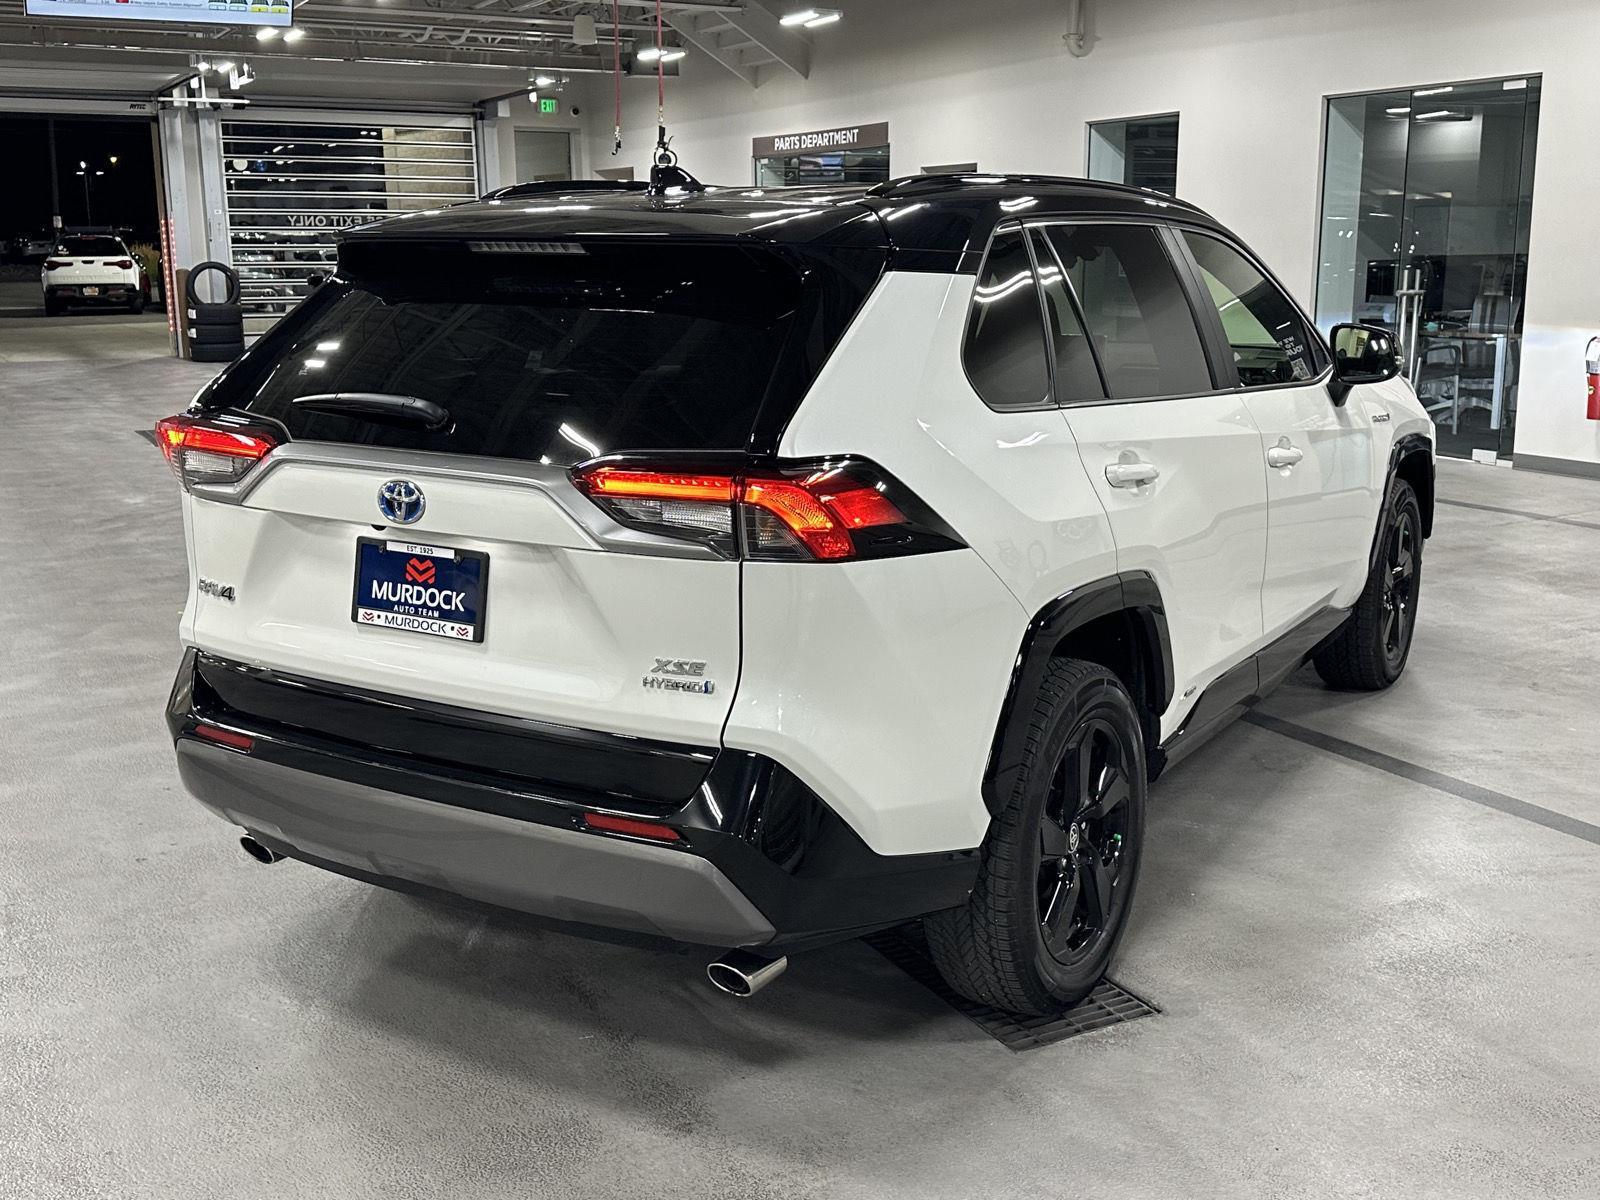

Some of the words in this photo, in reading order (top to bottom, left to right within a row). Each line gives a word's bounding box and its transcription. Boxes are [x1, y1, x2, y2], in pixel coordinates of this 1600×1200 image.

[541, 100, 556, 112] EXIT
[774, 137, 800, 151] PARTS
[801, 129, 859, 149] DEPARTMENT
[406, 545, 418, 553] EST.
[419, 547, 434, 555] 1925
[198, 578, 236, 602] RAV4
[371, 579, 466, 612] MURDOCK
[393, 604, 415, 614] AUTO
[418, 607, 440, 618] TEAM
[384, 614, 447, 634] MURDOCK
[650, 657, 707, 677] XSE
[642, 676, 703, 693] HYBRID
